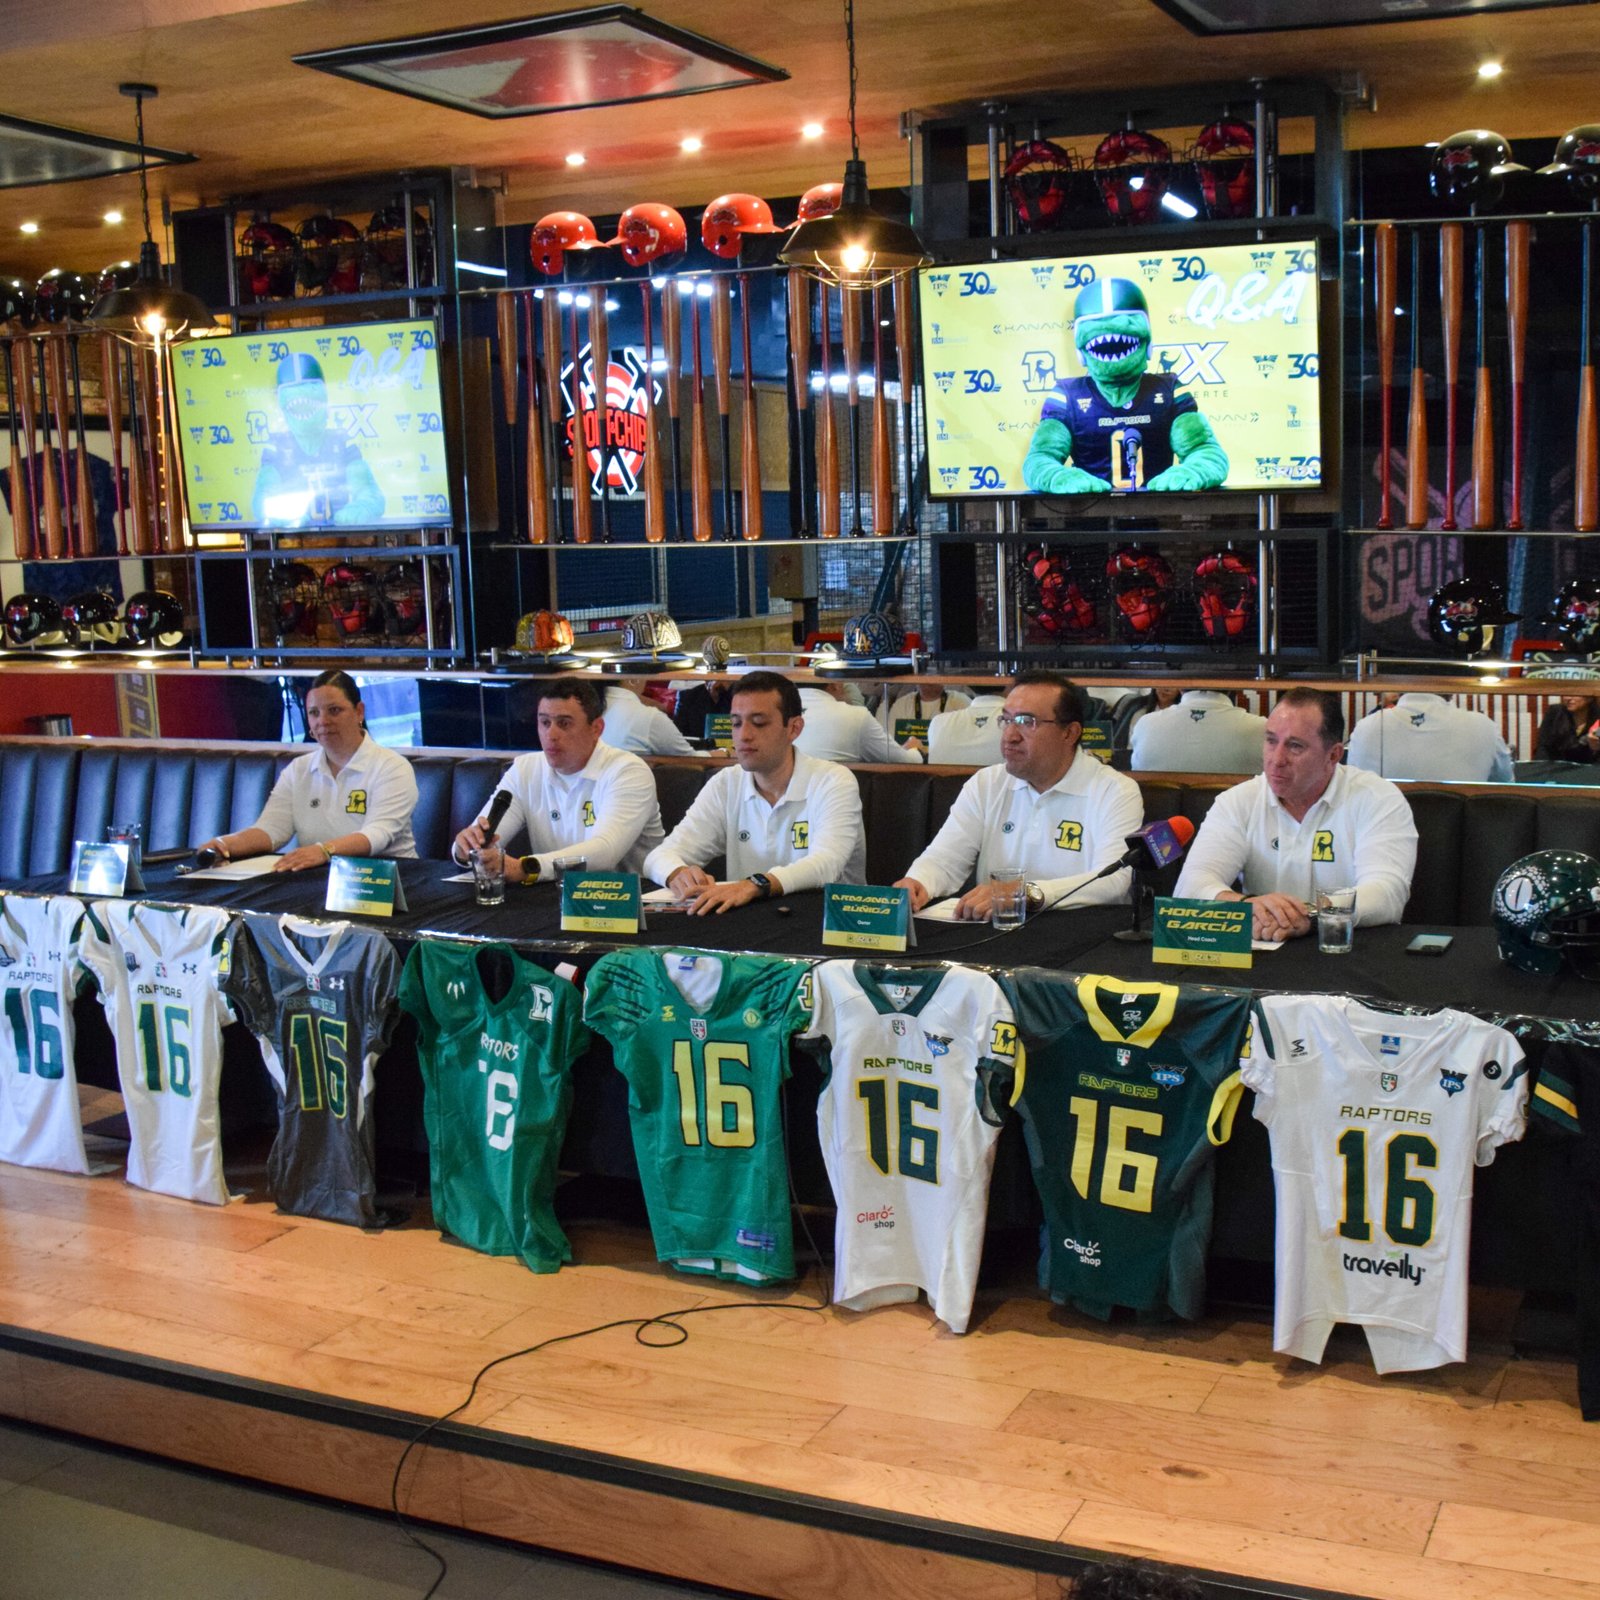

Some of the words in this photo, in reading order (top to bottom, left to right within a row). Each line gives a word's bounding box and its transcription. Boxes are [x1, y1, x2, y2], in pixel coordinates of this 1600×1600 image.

[1187, 271, 1307, 330] Q&A
[1158, 907, 1246, 921] HORACIO
[1166, 920, 1242, 933] GARCÍA
[8, 970, 53, 983] RAPTORS
[137, 983, 182, 999] RAPTORS
[5, 987, 64, 1080] 16
[137, 1001, 192, 1098] 16
[290, 1014, 348, 1119] 16
[863, 1057, 933, 1075] RAPTORS
[1079, 1073, 1158, 1099] RAPTORS
[1156, 1072, 1180, 1083] IPS
[1443, 1079, 1462, 1090] IPS
[672, 1038, 757, 1149] 16
[1340, 1105, 1432, 1126] RAPTORS
[855, 1075, 941, 1187] 16
[1069, 1096, 1163, 1213] 16
[1336, 1126, 1440, 1249] 16
[857, 1210, 889, 1223] Claro
[874, 1219, 895, 1229] shop
[1063, 1238, 1095, 1256] Claro
[1080, 1255, 1101, 1268] shop
[1343, 1252, 1422, 1287] travelly
